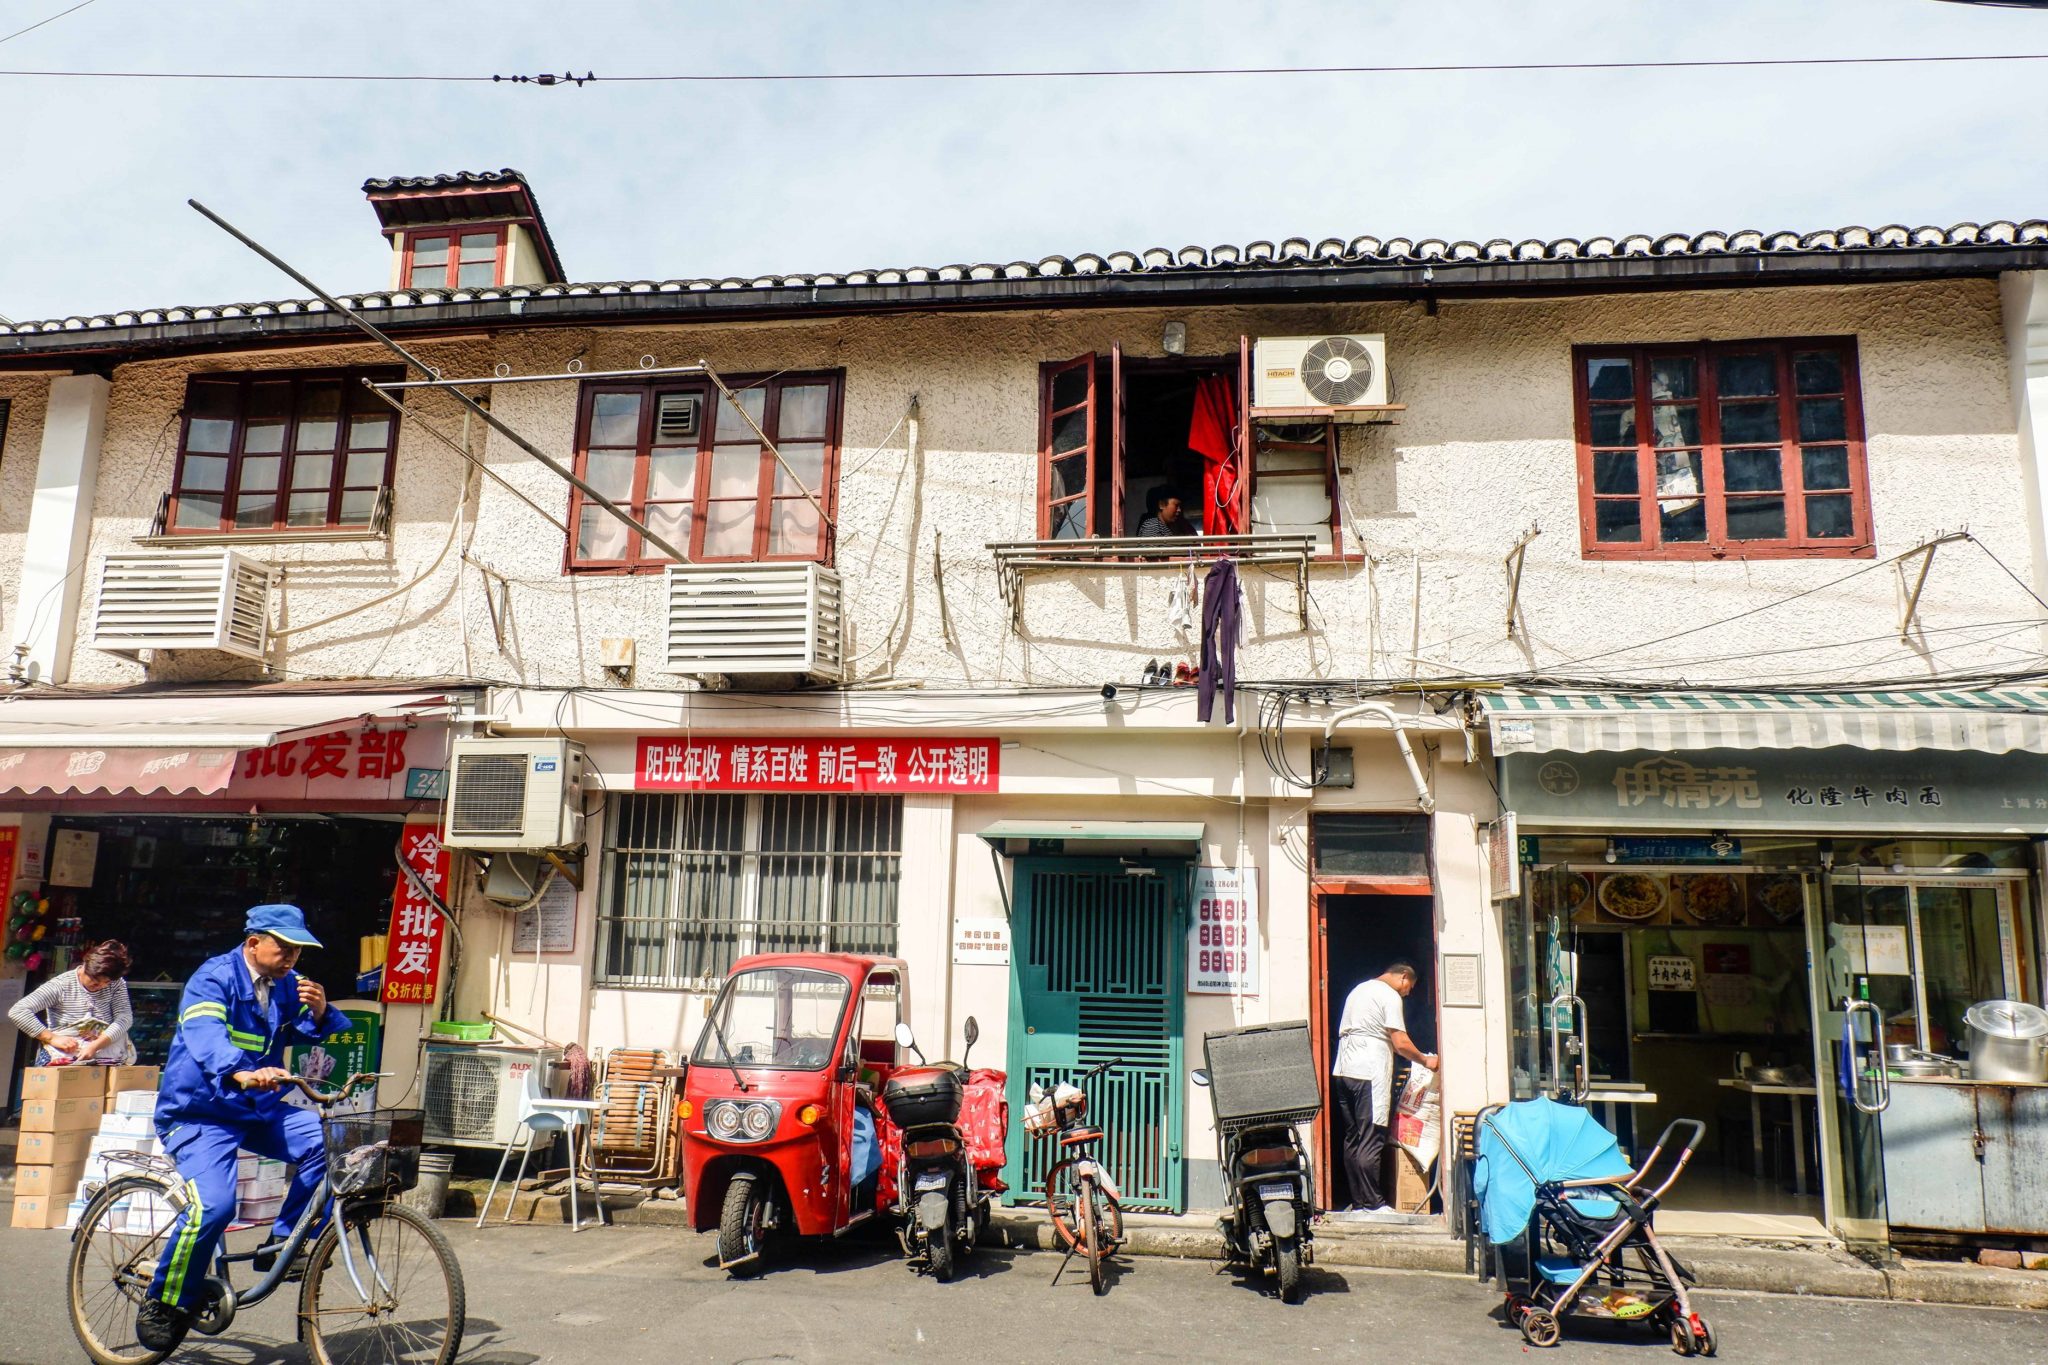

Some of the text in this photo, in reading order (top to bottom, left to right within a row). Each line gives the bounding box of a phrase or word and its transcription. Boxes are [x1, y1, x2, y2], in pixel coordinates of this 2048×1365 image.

[645, 744, 989, 785] 阳光征收 情系百姓 前后一致 公开透明
[417, 773, 438, 788] 24
[1612, 766, 1763, 809] 伊清苑
[1786, 784, 1942, 808] 化隆牛肉面
[393, 831, 444, 975] 冷饮批发
[386, 981, 434, 1000] 8折优惠
[510, 1062, 532, 1071] AUX
